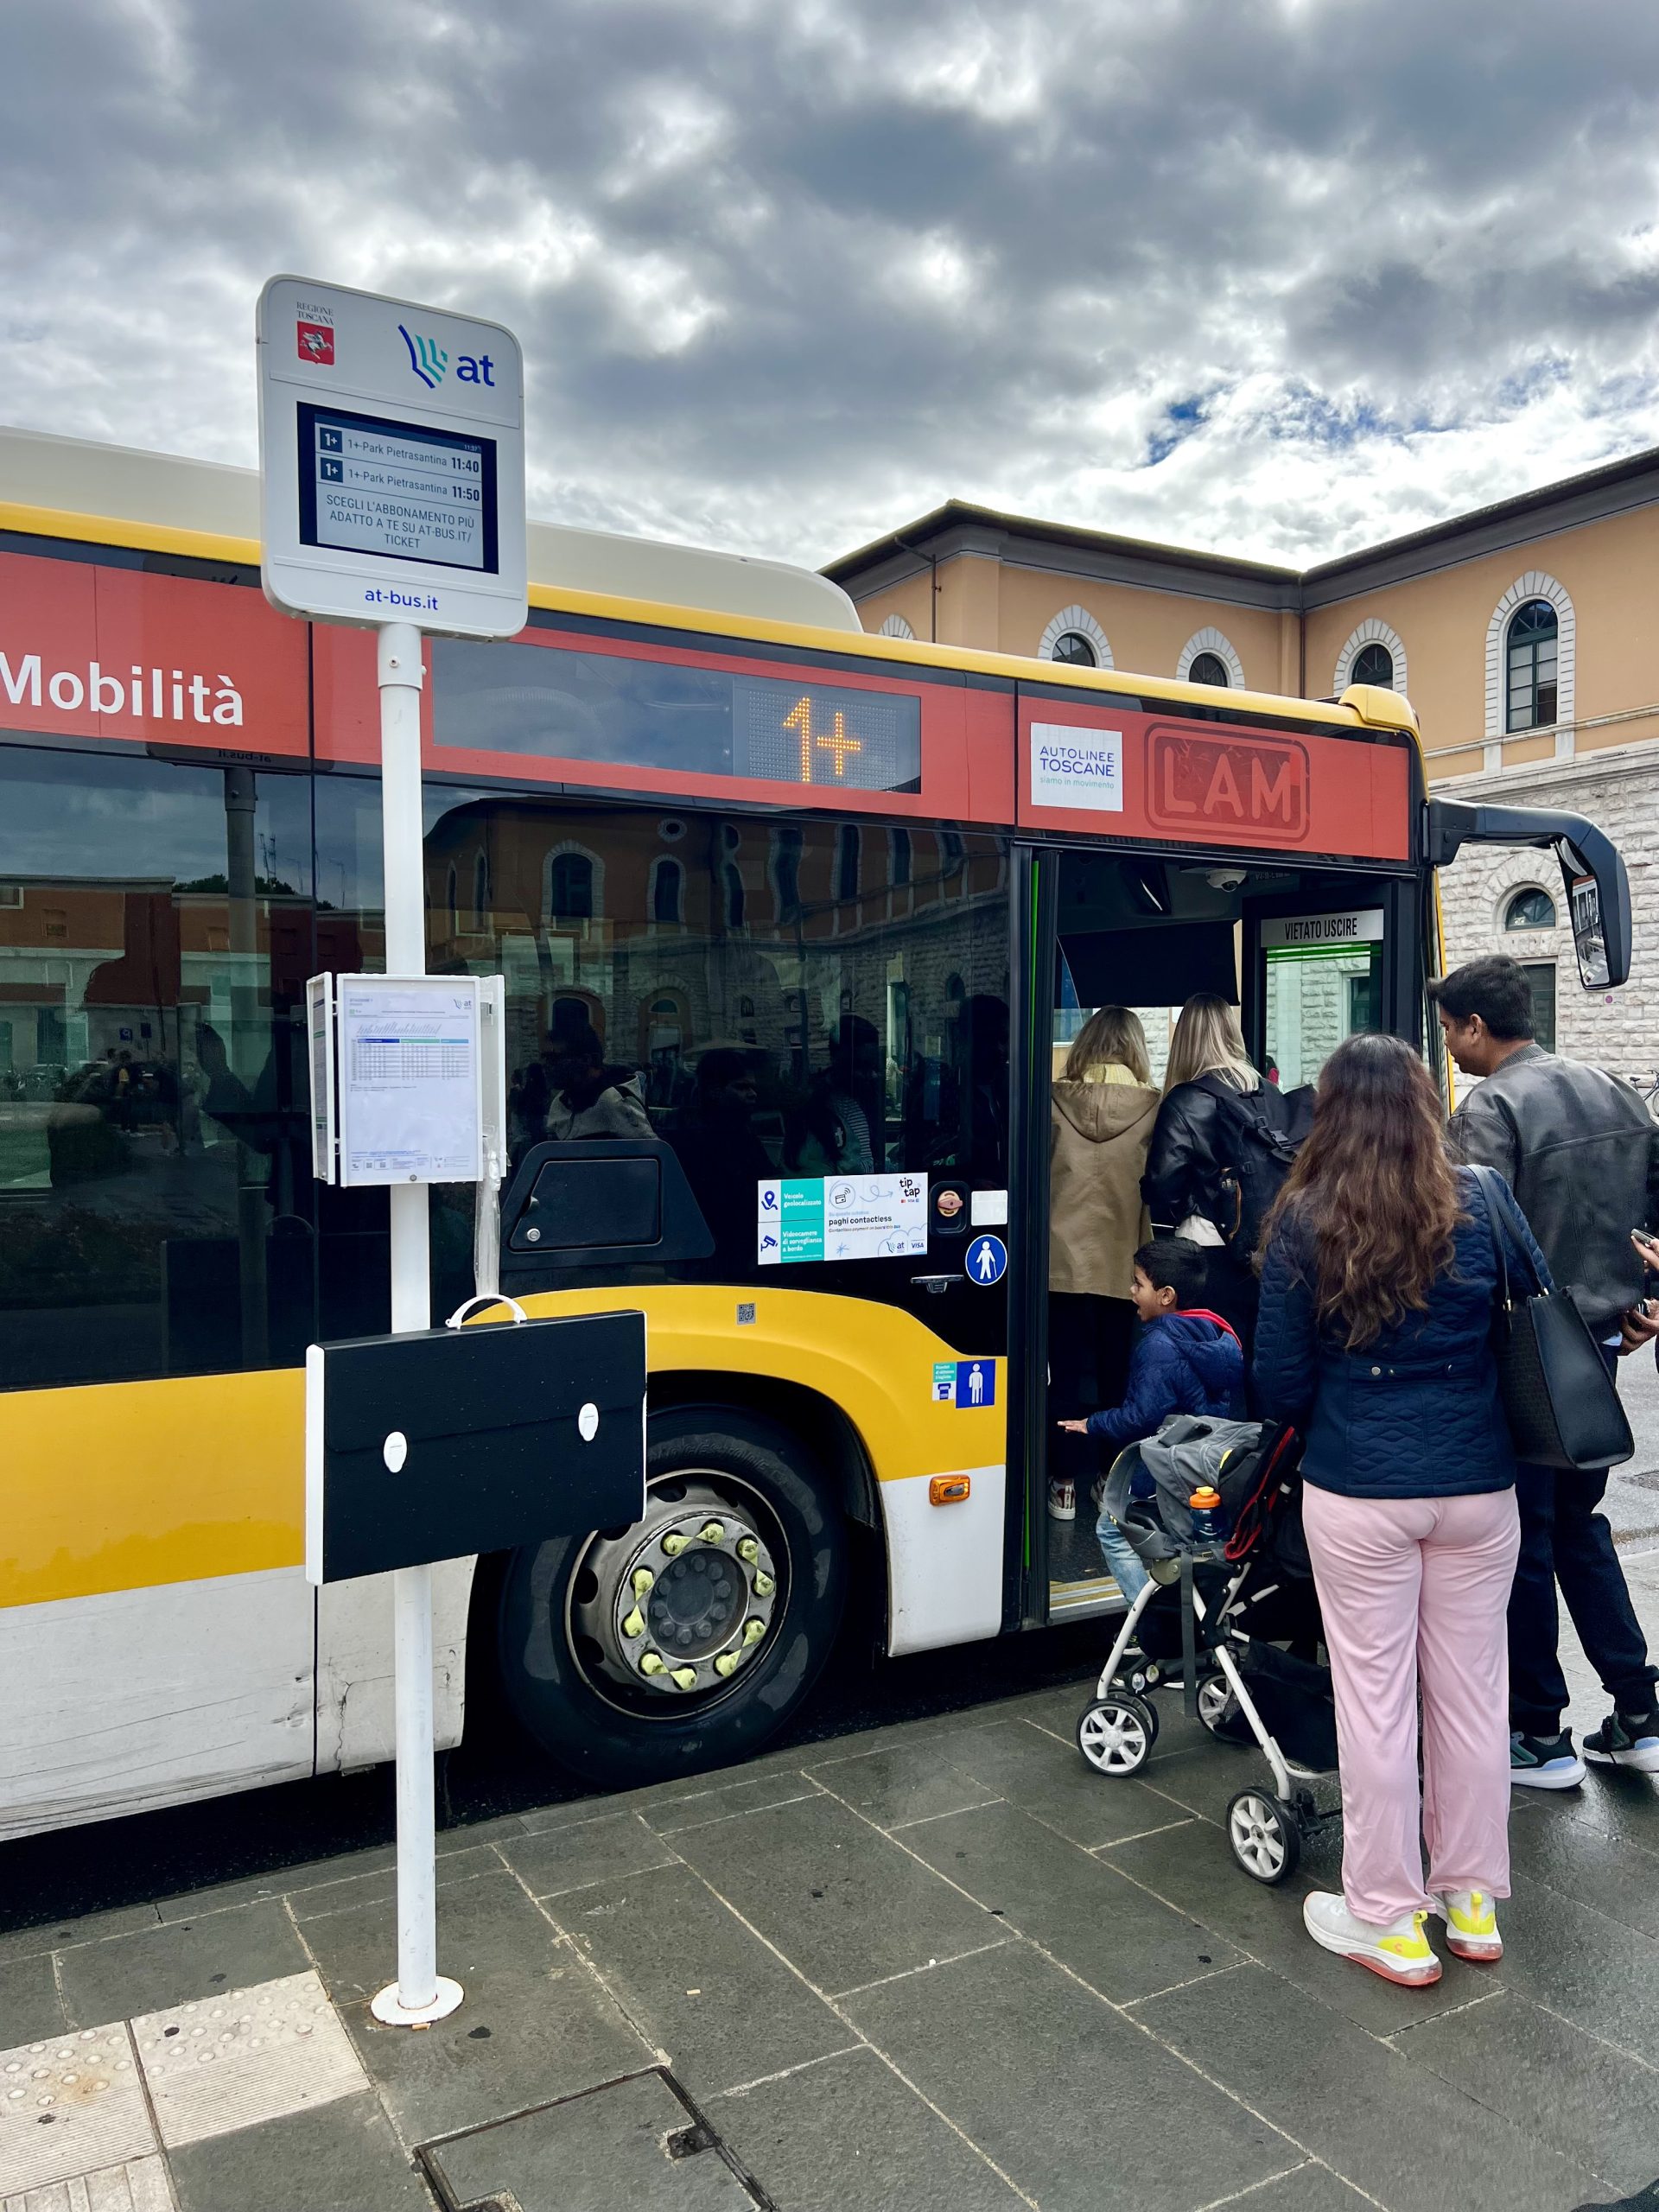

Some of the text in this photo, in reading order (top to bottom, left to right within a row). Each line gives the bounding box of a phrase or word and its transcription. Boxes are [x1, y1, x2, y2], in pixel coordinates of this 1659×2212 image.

[296, 302, 334, 316] REGIONE
[297, 310, 334, 326] TOSCANA
[456, 354, 494, 386] at
[324, 433, 338, 447] 1+
[386, 447, 448, 467] Pietrasantina
[451, 457, 480, 473] 11:40
[325, 462, 339, 476] 1+
[387, 476, 448, 495] Pietrasantina
[452, 486, 480, 502] 11:50
[326, 494, 475, 529] SCEGLI L'ABBONAMENTO PIÙ
[329, 511, 472, 543] ADATTO A TE SU AT-BUS.IT/
[384, 533, 421, 549] TICKET
[365, 588, 439, 610] at-bus.it
[0, 652, 244, 726] Mobilità
[782, 696, 862, 783] 1+
[1039, 746, 1115, 762] AUTOLINEE
[1039, 758, 1115, 777] TOSCANE
[1039, 777, 1063, 785] siamo
[1073, 779, 1115, 790] movimento
[1163, 746, 1292, 823] LAM
[1284, 918, 1357, 940] VIETATO USCIRE
[899, 1177, 913, 1189] tip
[903, 1187, 920, 1198] tap
[829, 1215, 893, 1226] paghi contactless
[896, 1241, 905, 1249] at
